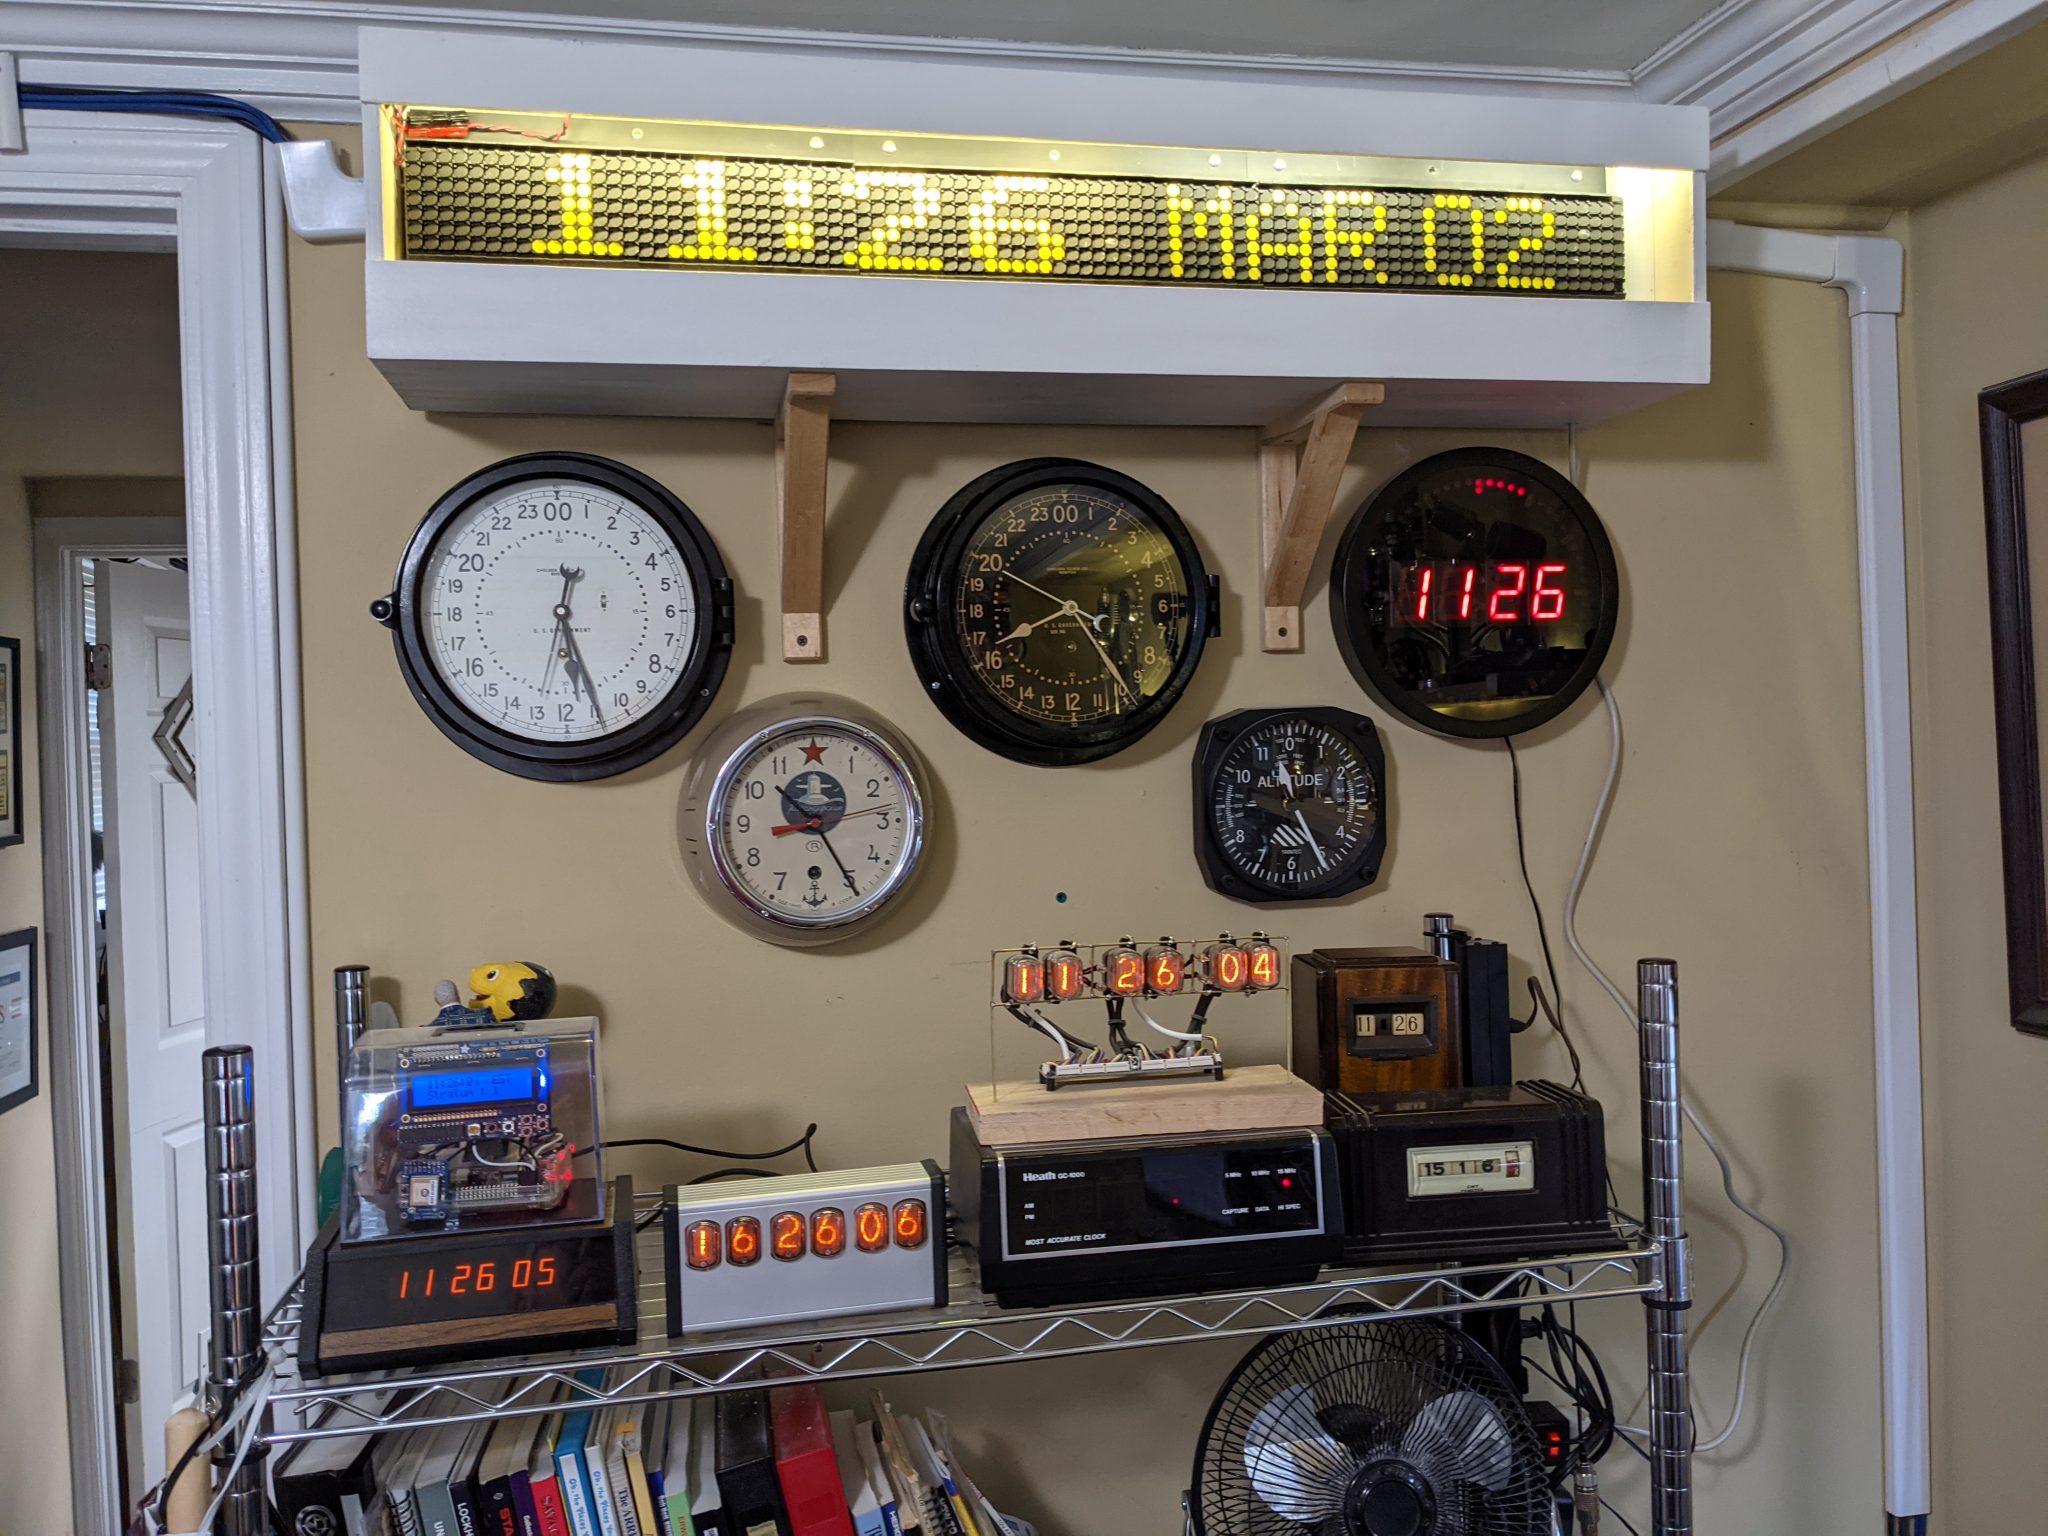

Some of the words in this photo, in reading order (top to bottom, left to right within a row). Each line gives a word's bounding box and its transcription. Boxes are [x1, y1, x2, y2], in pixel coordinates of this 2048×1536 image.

[531, 151, 1065, 275] 11:26
[1165, 182, 1389, 287] MAR
[1421, 193, 1556, 291] 02
[517, 504, 538, 520] 23
[543, 503, 573, 522] 00
[583, 504, 589, 519] 1
[1030, 506, 1049, 522] 23
[1052, 505, 1079, 524] 00
[1087, 506, 1093, 521] 1
[491, 516, 512, 531] 22
[606, 516, 617, 531] 2
[1007, 518, 1027, 533] 22
[1107, 517, 1118, 531] 2
[476, 531, 490, 546] 21
[629, 531, 641, 546] 3
[994, 533, 1008, 548] 21
[1127, 531, 1138, 545] 3
[457, 553, 485, 573] 20
[644, 552, 659, 572] 4
[979, 553, 1003, 572] 20
[1140, 550, 1152, 569] 4
[447, 579, 463, 594] 19
[660, 577, 671, 592] 5
[969, 577, 984, 592] 19
[1154, 573, 1164, 588] 5
[665, 604, 676, 619] 6
[969, 604, 984, 618] 18
[1157, 599, 1169, 613] 6
[447, 607, 463, 622] 18
[972, 631, 987, 646] 17
[1157, 625, 1167, 640] 7
[450, 636, 465, 651] 17
[664, 633, 675, 648] 7
[985, 651, 1003, 670] 16
[1143, 646, 1156, 665] 8
[465, 657, 484, 677] 16
[648, 653, 662, 674] 8
[1000, 674, 1015, 689] 15
[1132, 669, 1143, 684] 9
[483, 683, 498, 698] 15
[636, 680, 647, 694] 9
[1019, 686, 1035, 701] 14
[504, 696, 521, 710] 14
[613, 693, 629, 708] 10
[1041, 695, 1056, 709] 13
[1065, 692, 1080, 711] 12
[1092, 693, 1103, 707] 11
[528, 705, 545, 721] 13
[557, 703, 575, 723] 12
[1284, 737, 1296, 751] 0
[1255, 747, 1269, 761] 11
[1317, 745, 1324, 759] 1
[772, 755, 787, 775] 11
[848, 756, 854, 774] 1
[1235, 769, 1251, 784] 10
[1336, 766, 1346, 781] 2
[744, 780, 765, 800] 10
[866, 778, 880, 798] 2
[736, 814, 750, 833] 9
[876, 811, 890, 830] 3
[1235, 829, 1246, 844] 8
[1335, 825, 1346, 839] 4
[747, 847, 761, 867] 8
[866, 844, 881, 864] 4
[1286, 856, 1297, 870] 6
[772, 871, 787, 891] 7
[1021, 963, 1068, 994] 11
[1116, 956, 1176, 989] 26
[1220, 952, 1272, 984] 04
[1358, 1016, 1370, 1033] 11
[1394, 1015, 1419, 1032] 26
[1022, 1171, 1057, 1182] Heath
[1424, 1162, 1445, 1177] 15
[1221, 1207, 1250, 1215] CAPTURE
[1254, 1205, 1270, 1213] DATA
[777, 1215, 838, 1249] 26
[1024, 1238, 1045, 1246] MOST
[1046, 1235, 1082, 1244] ACCURATE
[1083, 1233, 1107, 1241] CLOCK
[399, 1267, 435, 1299] 11
[450, 1262, 496, 1295] 26
[511, 1257, 556, 1289] 05
[618, 1487, 629, 1508] The
